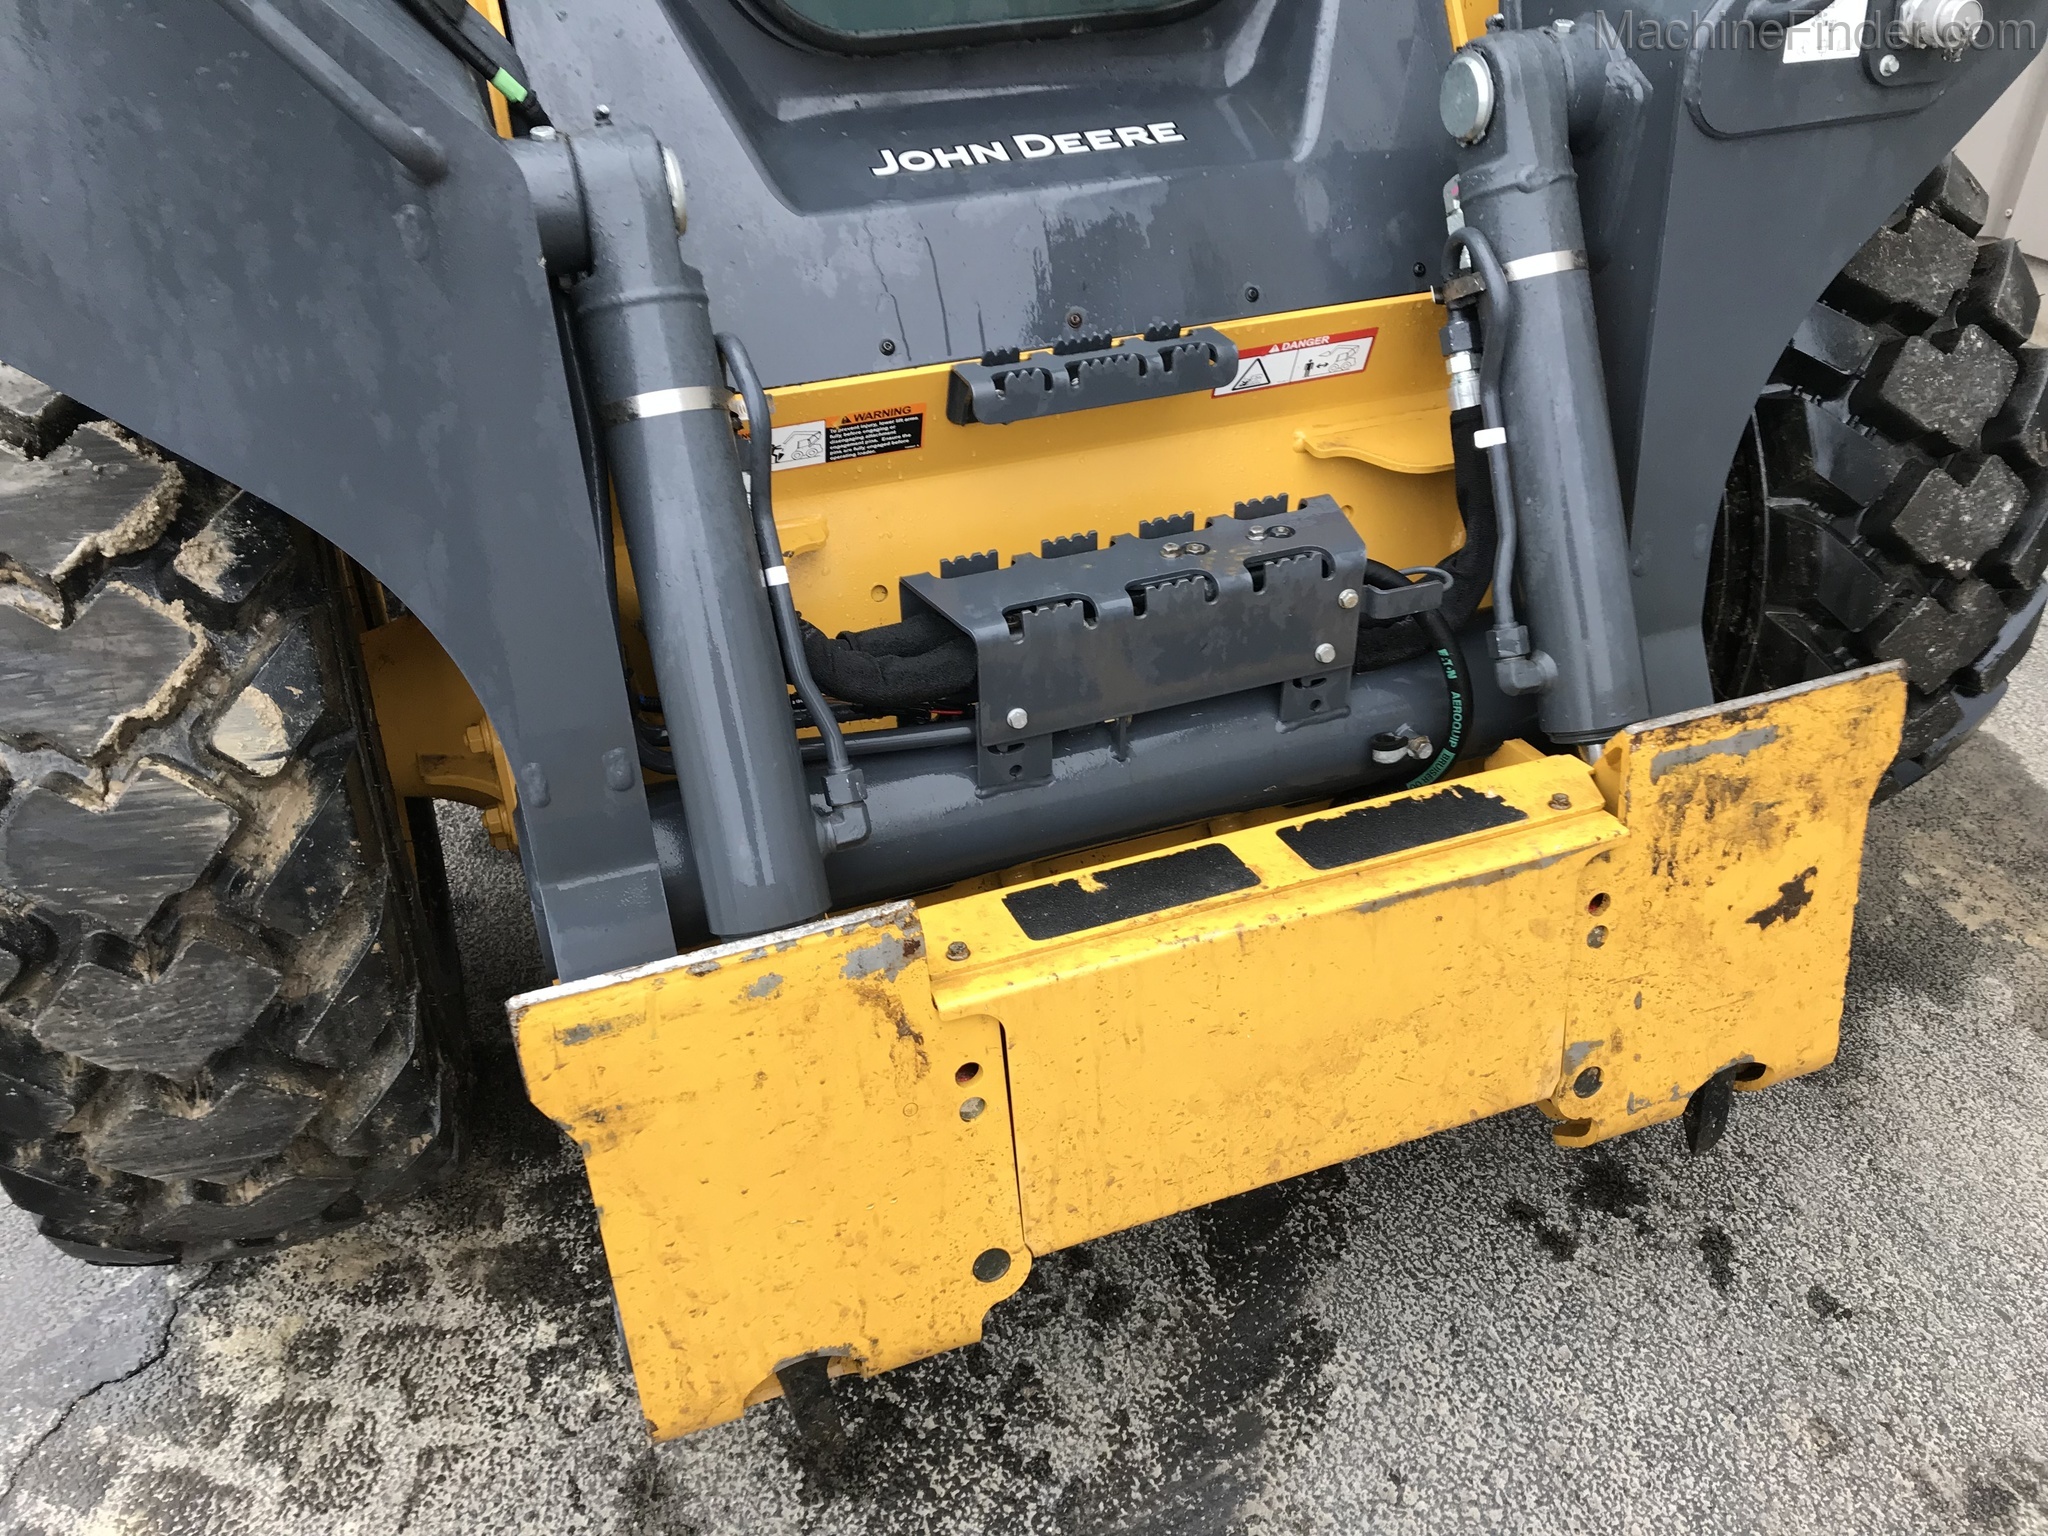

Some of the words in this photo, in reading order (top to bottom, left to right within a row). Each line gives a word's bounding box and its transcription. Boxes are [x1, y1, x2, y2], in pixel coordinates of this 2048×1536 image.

[871, 140, 1011, 177] JOHN
[1012, 120, 1186, 160] DEERE
[1281, 335, 1331, 351] DANGER
[853, 405, 912, 422] WARNING
[1449, 691, 1463, 748] AEROQUIP
[1421, 752, 1450, 784] BRUISER
